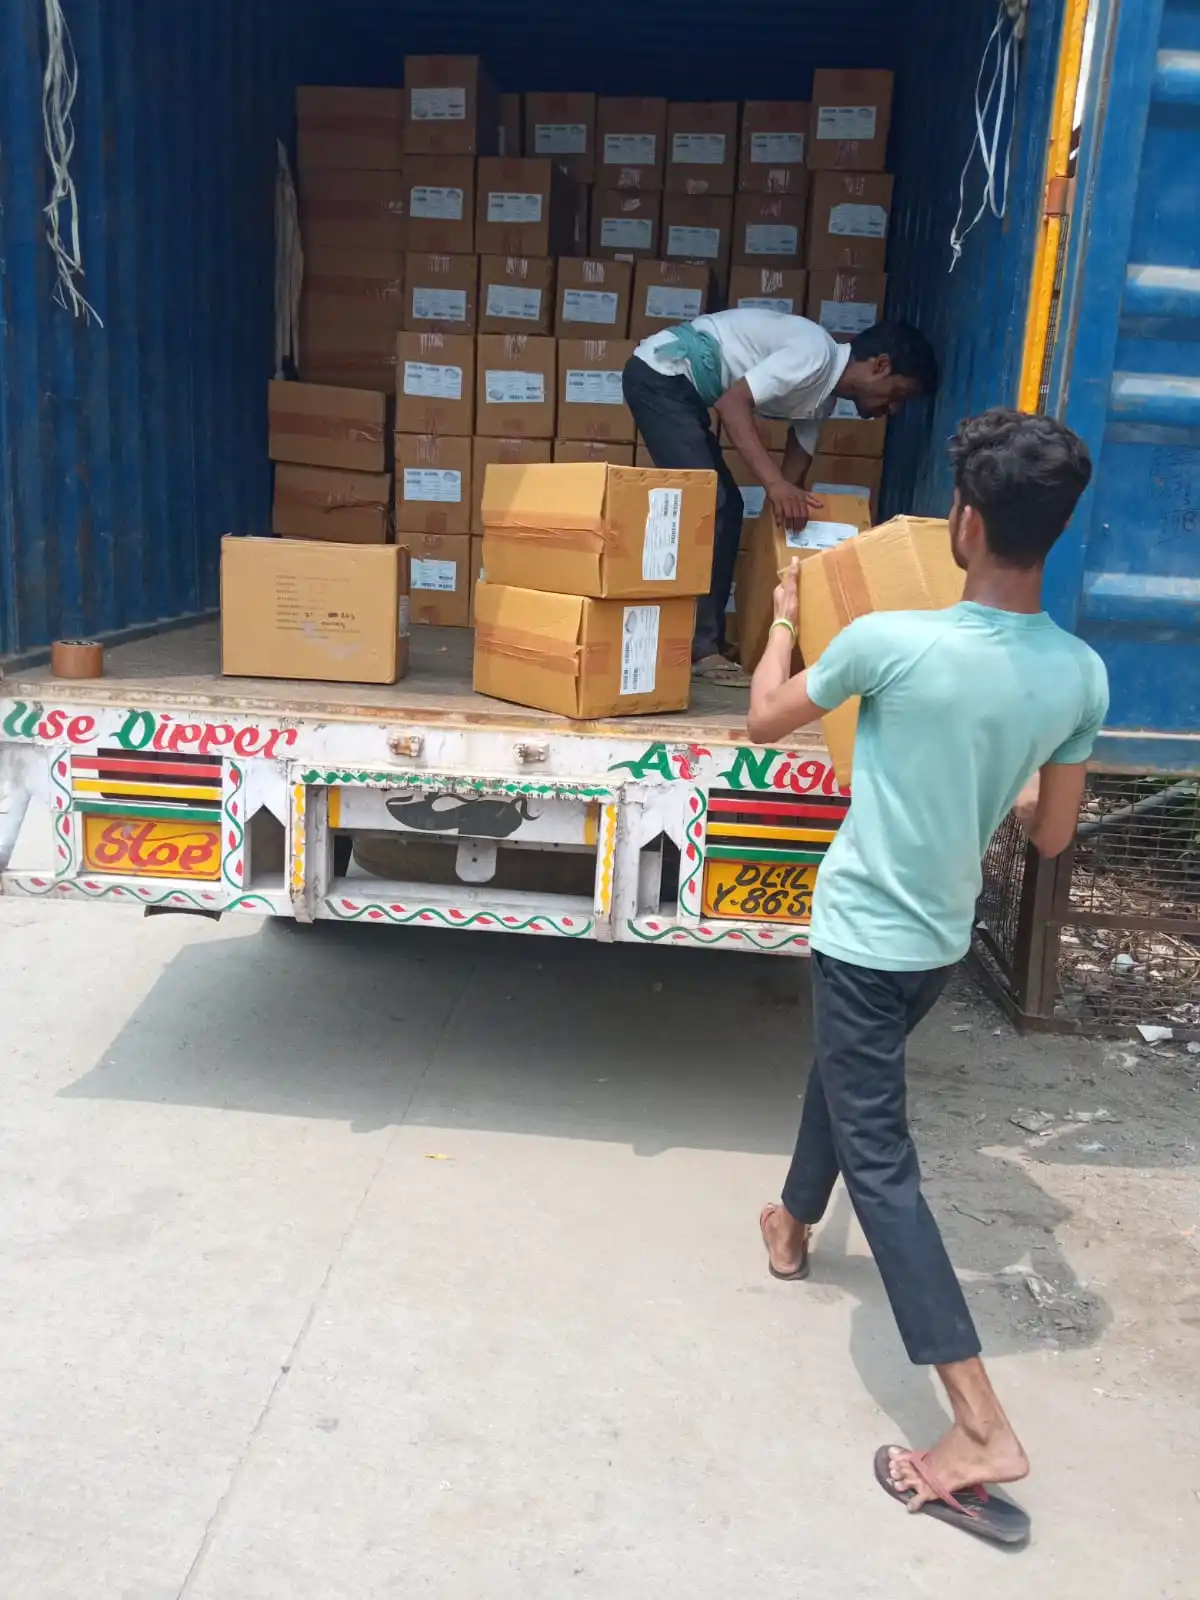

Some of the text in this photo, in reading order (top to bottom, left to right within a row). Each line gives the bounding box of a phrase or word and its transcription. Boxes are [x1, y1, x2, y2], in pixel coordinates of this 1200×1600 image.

[2, 701, 298, 759] Use Dipper
[608, 743, 712, 780] At
